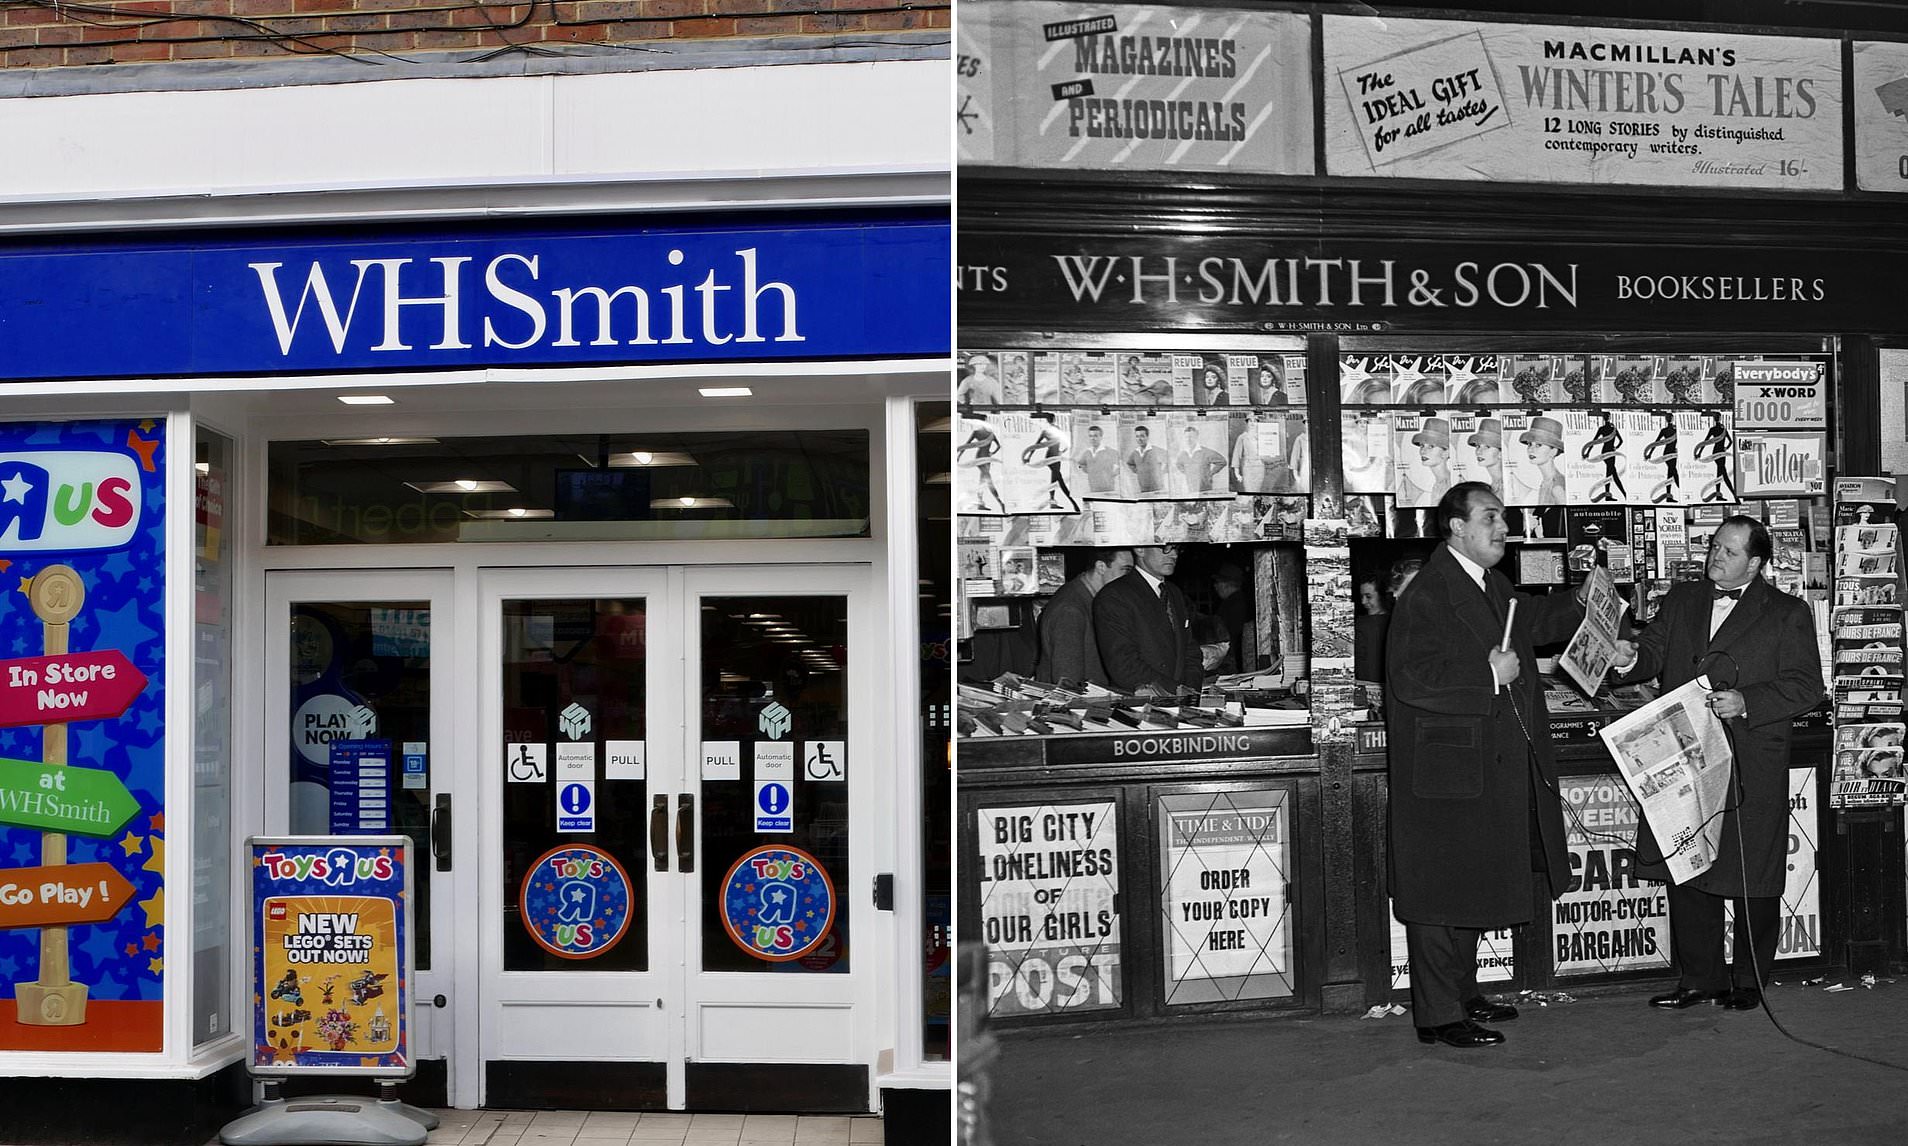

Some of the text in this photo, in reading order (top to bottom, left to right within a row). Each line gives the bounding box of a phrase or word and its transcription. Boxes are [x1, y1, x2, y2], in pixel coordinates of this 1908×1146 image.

[1047, 18, 1115, 39] ILLUSTRATED
[1074, 34, 1236, 78] MAGAZINES
[1543, 41, 1737, 66] MACMILLAN'S
[957, 54, 981, 77] ES
[1061, 84, 1082, 96] AND
[1356, 72, 1395, 96] The
[1518, 64, 1817, 119] WINTER'S TALES
[1362, 68, 1484, 125] IDEAL GIFT
[1068, 98, 1246, 141] PERIODICALS
[1374, 98, 1489, 153] for all tastes
[1544, 117, 1785, 146] 12 LONG STORIES by distinguished
[1544, 138, 1702, 160] contemporary writers.
[1408, 268, 1448, 307] &
[1454, 261, 1579, 308] SON
[1617, 275, 1825, 301] BOOKSELLERS
[248, 248, 806, 355] WHSmith
[1174, 357, 1202, 367] REVUE
[1230, 357, 1257, 367] REVUE
[1735, 366, 1816, 381] Everybody's
[1396, 417, 1420, 430] MATCH
[1451, 418, 1475, 431] MATCH
[1503, 416, 1527, 429] MATCH
[1873, 627, 1901, 638] FRANCE
[1872, 652, 1902, 663] FRANCE
[9, 663, 117, 688] In Store
[37, 689, 88, 711] Now
[1114, 736, 1250, 756] BOOKBINDING
[558, 754, 593, 762] Automatic
[611, 756, 640, 765] PULL
[706, 757, 735, 766] PULL
[756, 753, 792, 761] Automatic
[40, 770, 67, 792] at
[0, 788, 112, 824] WHSmith
[560, 820, 575, 828] Keep
[758, 820, 774, 828] Keep
[995, 812, 1095, 844] BIG CITY
[1177, 816, 1276, 834] TIME & TIDE
[1193, 836, 1245, 844] INDEPENDENT
[980, 849, 1113, 882] LONELINESS
[1200, 870, 1250, 891] ORDER
[0, 883, 34, 905] Go
[40, 882, 93, 909] Play
[1034, 888, 1062, 904] OF
[270, 907, 286, 915] LEGO
[1182, 897, 1270, 922] YOUR COPY
[1556, 896, 1667, 924] MOTOR-CYCLE
[299, 914, 358, 934] NEW
[986, 911, 1112, 944] OUR GIRLS
[334, 936, 373, 949] SETS
[1209, 931, 1245, 951] HERE
[1557, 928, 1657, 962] BARGAINS
[288, 950, 369, 963] OUT NOW!
[988, 954, 1120, 1011] POST
